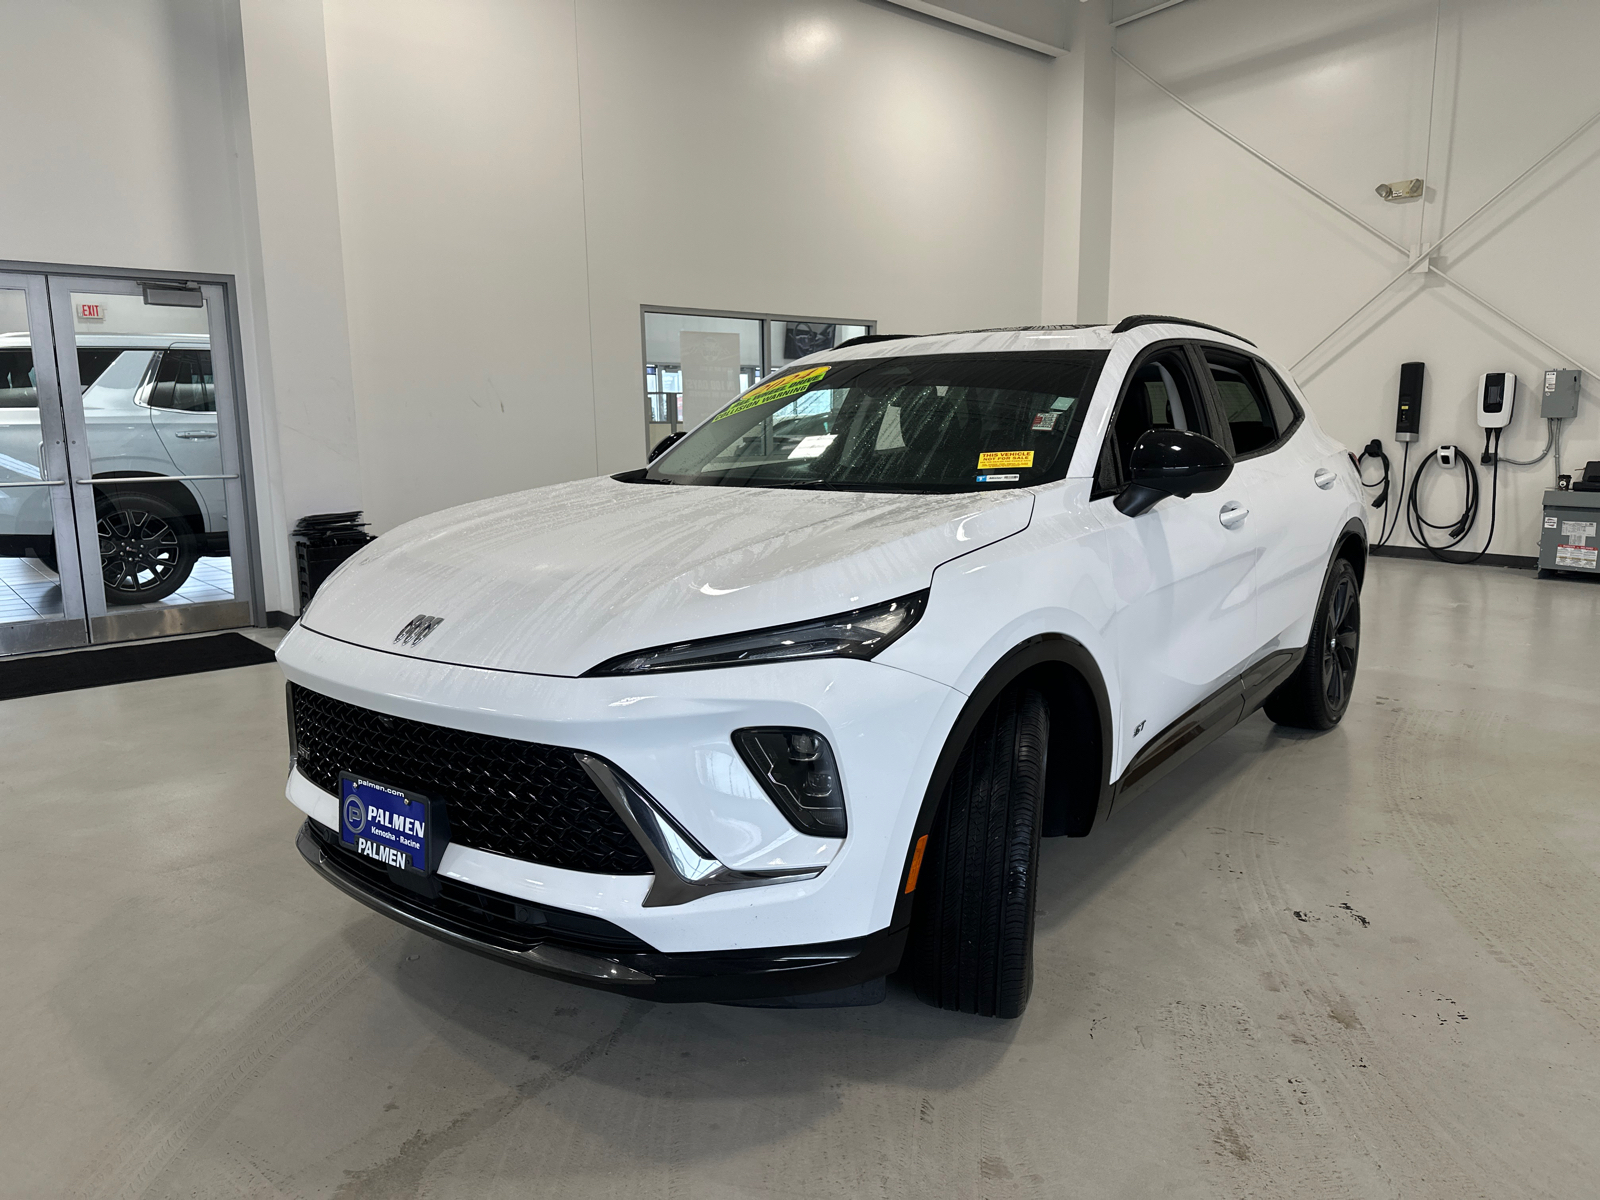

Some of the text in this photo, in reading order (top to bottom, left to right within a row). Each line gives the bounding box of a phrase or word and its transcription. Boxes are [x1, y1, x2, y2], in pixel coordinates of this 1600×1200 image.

[82, 305, 99, 317] EXIT
[762, 385, 808, 403] WARNING
[357, 779, 405, 798] palmen.com
[367, 805, 425, 838] PALMEN
[371, 826, 396, 841] Kenosha
[399, 835, 421, 849] Racine
[358, 838, 406, 869] PALMEN
